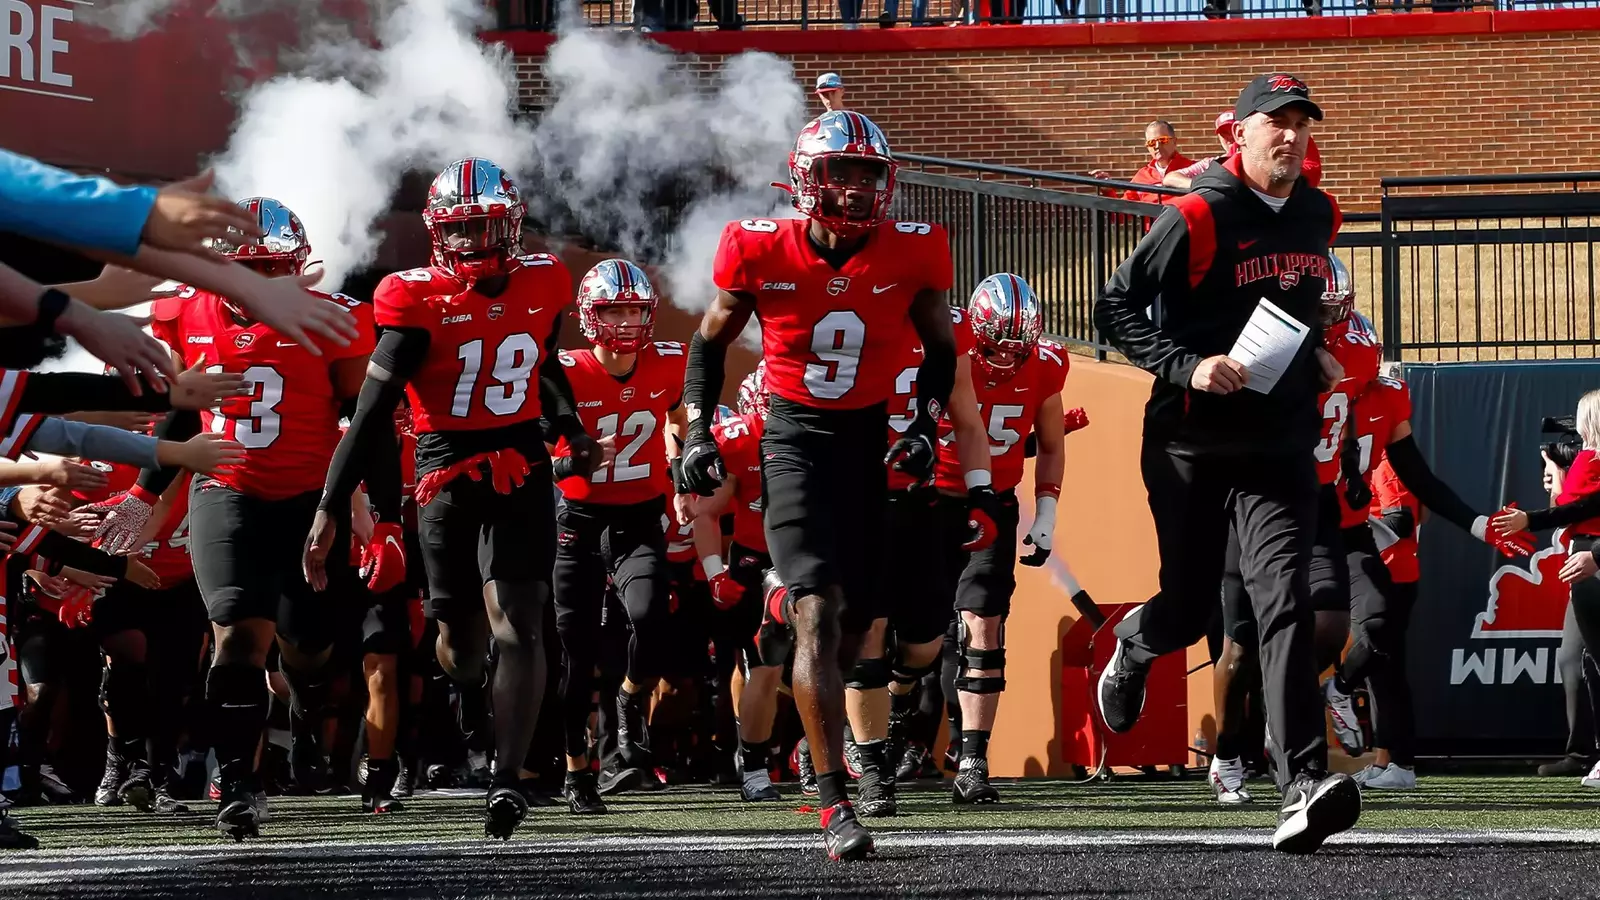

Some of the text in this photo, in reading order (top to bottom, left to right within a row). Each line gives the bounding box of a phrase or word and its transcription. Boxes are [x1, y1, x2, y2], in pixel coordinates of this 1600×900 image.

[451, 332, 539, 417] 19
[803, 311, 865, 399] 9
[591, 410, 656, 483] 12
